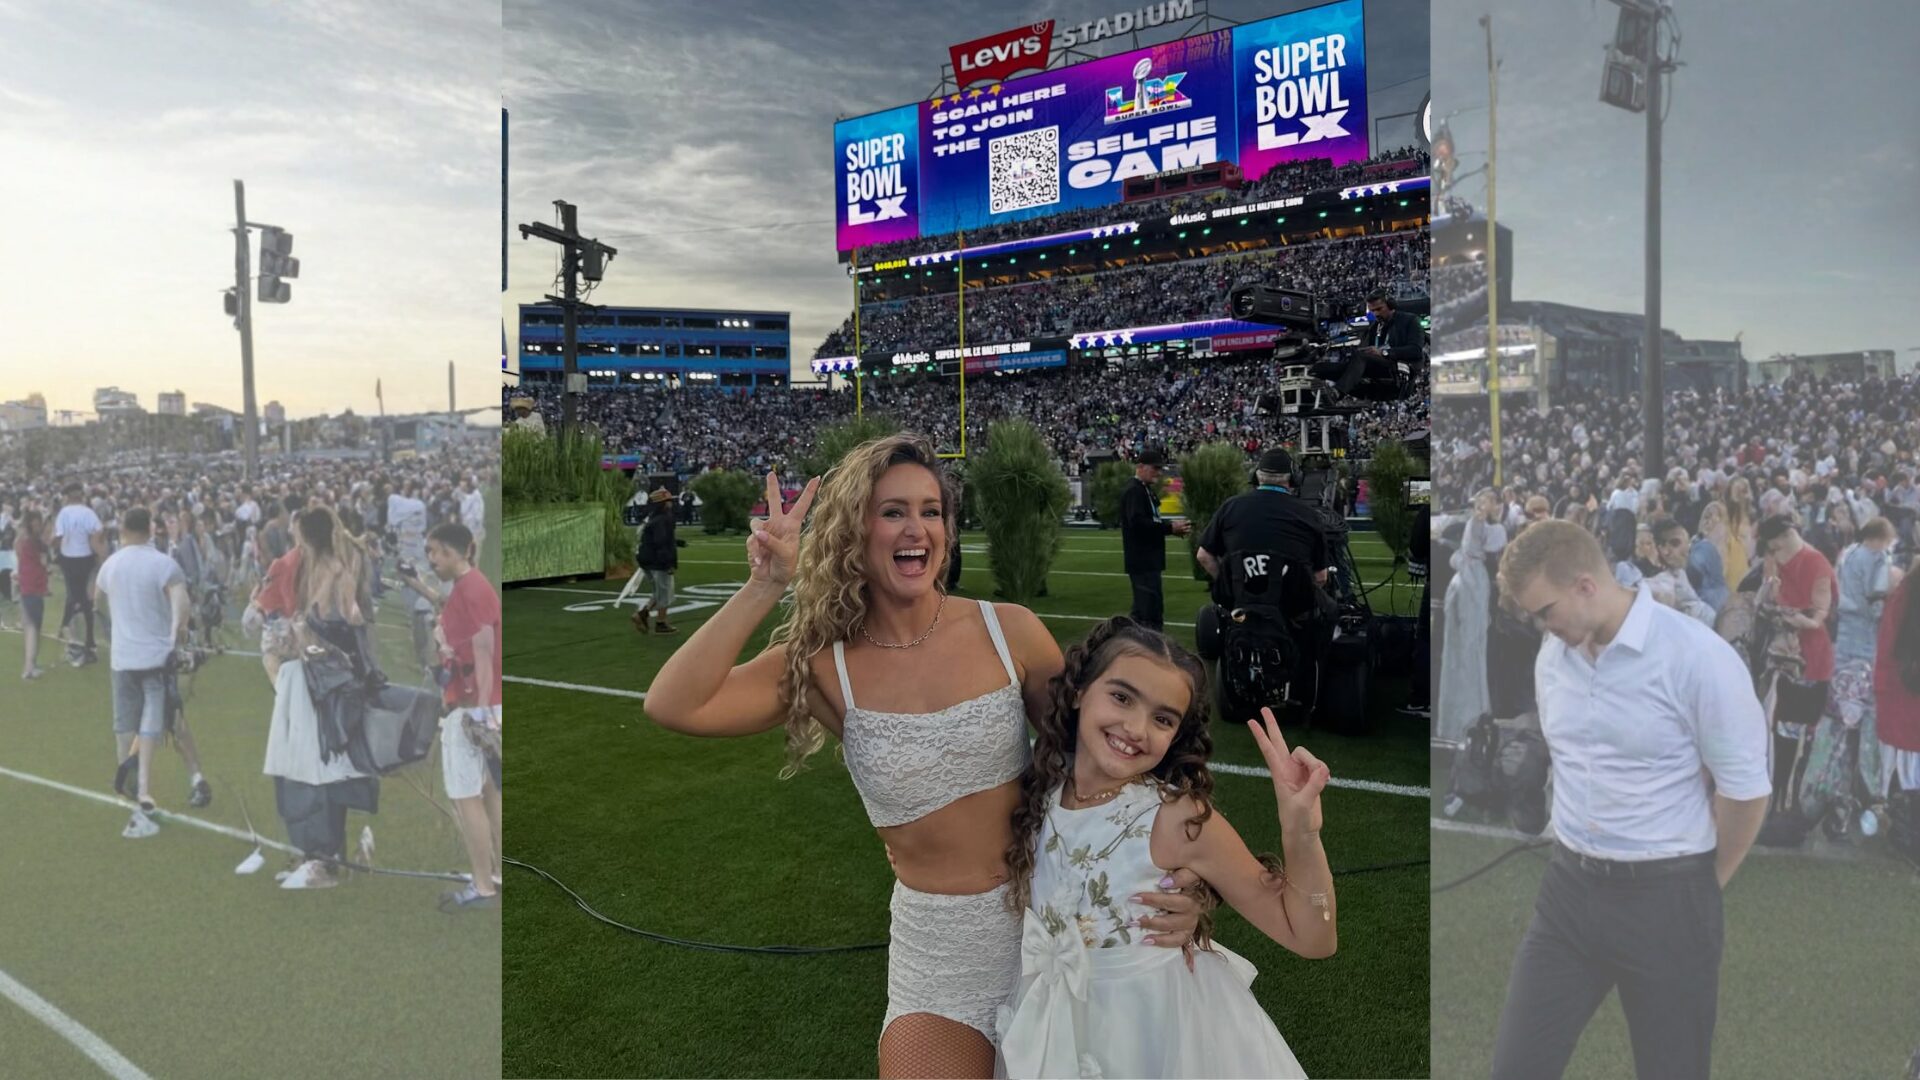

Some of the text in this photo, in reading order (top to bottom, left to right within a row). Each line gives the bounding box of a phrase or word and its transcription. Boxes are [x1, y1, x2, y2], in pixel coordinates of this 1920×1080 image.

[1061, 0, 1195, 50] STADIUM
[1253, 33, 1347, 84] SUPER
[933, 84, 1066, 124] SCAN HERE
[1115, 104, 1180, 120] SUPER BOWL
[1256, 71, 1350, 123] BOWL
[932, 108, 1034, 140] TO JOIN
[1067, 116, 1217, 162] SELFIE
[1257, 109, 1351, 151] LX
[845, 132, 906, 172] SUPER
[933, 137, 981, 156] THE
[1067, 137, 1217, 189] CAM
[847, 163, 907, 204] BOWL
[847, 194, 908, 227] LX
[1177, 211, 1207, 224] Music
[1212, 208, 1231, 218] SUPER
[1231, 205, 1248, 215] BOWL
[1257, 199, 1285, 211] HALFTIME
[1285, 196, 1304, 207] SHOW
[900, 351, 930, 364] Music
[935, 349, 955, 360] SUPER
[981, 343, 1011, 356] HALFTIME
[1011, 342, 1031, 352] SHOW
[985, 354, 1061, 367] SEAHAWKS
[1228, 336, 1254, 345] ENGLAND
